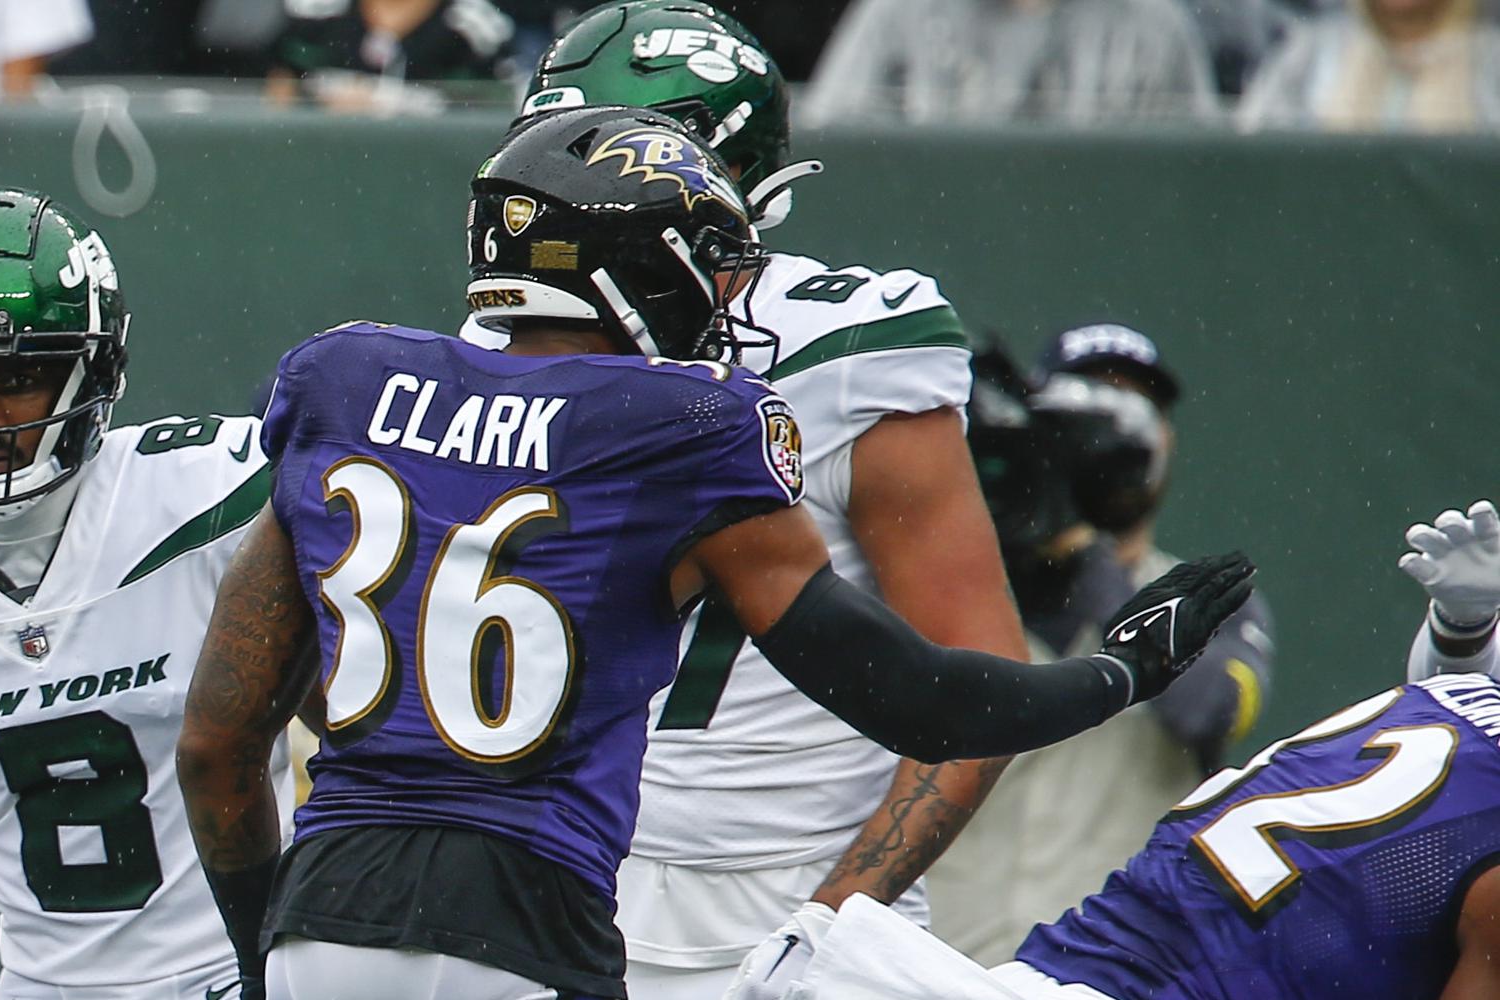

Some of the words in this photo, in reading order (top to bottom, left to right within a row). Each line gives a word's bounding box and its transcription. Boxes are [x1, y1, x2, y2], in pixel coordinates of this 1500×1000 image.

[633, 28, 769, 76] JETS
[468, 288, 528, 311] VENS
[785, 274, 871, 304] 8
[137, 415, 223, 456] 8
[367, 372, 568, 473] CLARK
[316, 455, 578, 766] 36
[38, 653, 172, 709] YORK
